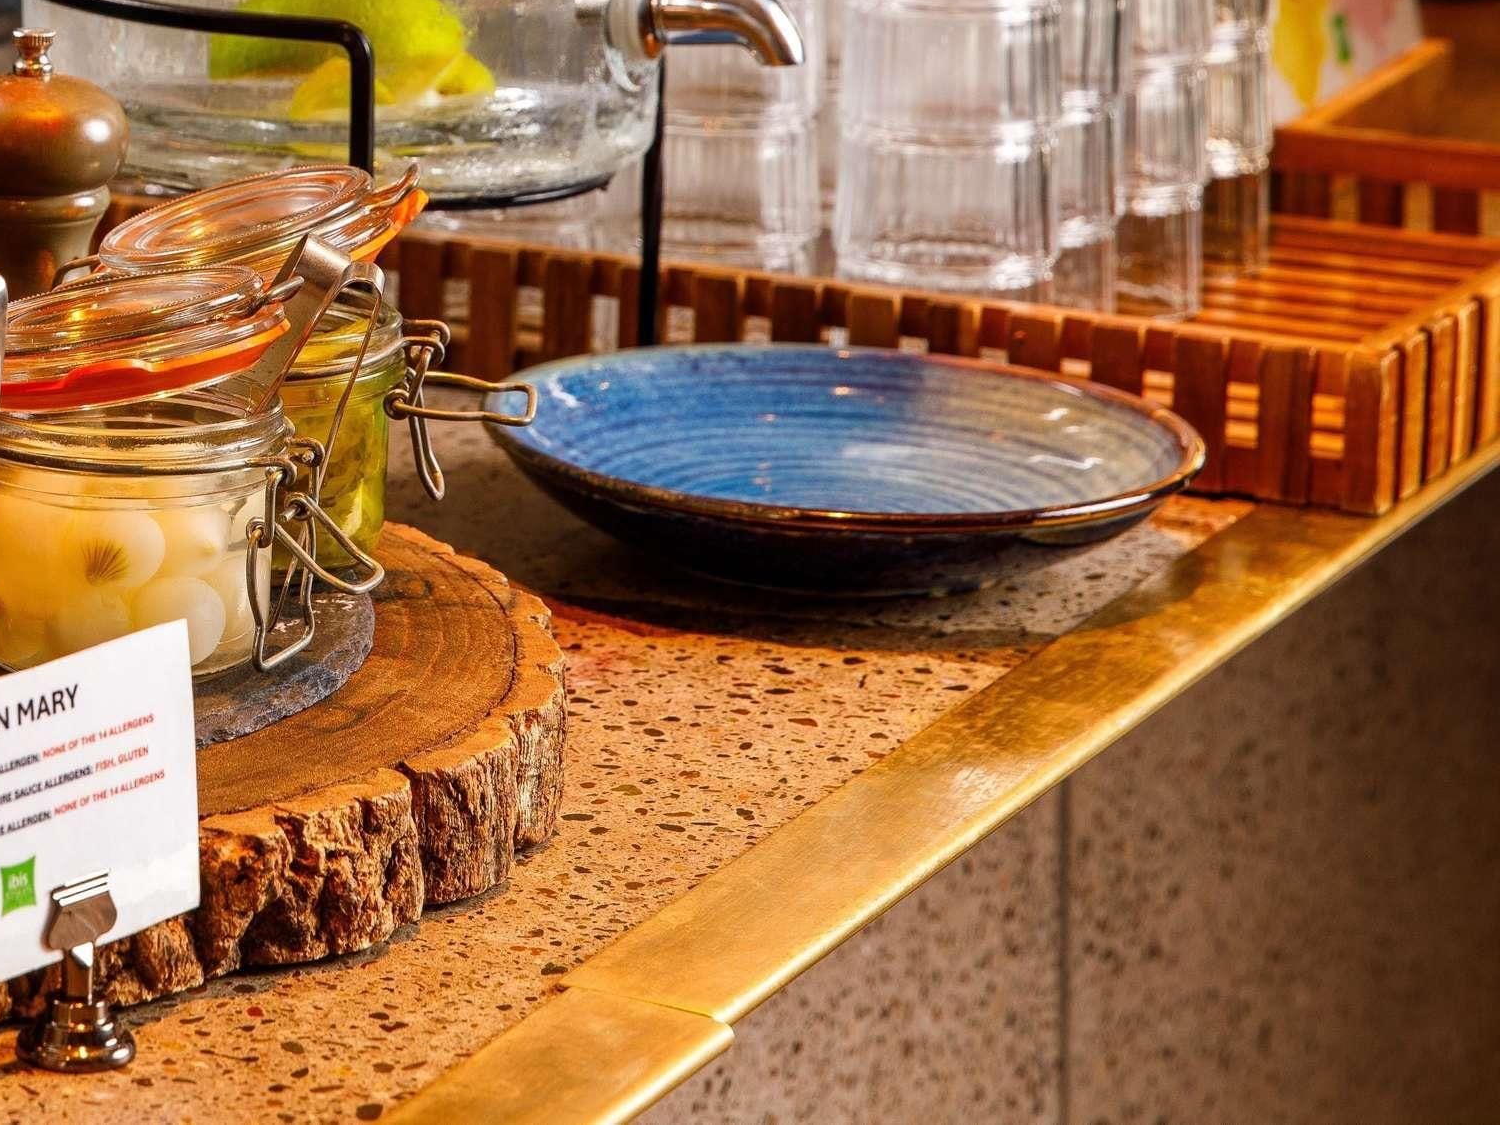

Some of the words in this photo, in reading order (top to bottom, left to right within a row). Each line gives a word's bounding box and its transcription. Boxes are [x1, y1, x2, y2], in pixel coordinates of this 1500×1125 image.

[17, 683, 79, 726] MARY
[42, 743, 66, 758] NONE
[68, 739, 79, 750] OF
[81, 733, 96, 745] THE
[98, 730, 108, 740] 14
[108, 713, 155, 737] ALLERGENS
[14, 781, 42, 800] SAUCE
[117, 745, 149, 764] GLUTEN
[53, 800, 78, 816] NONE
[80, 796, 90, 807] OF
[92, 790, 107, 802] THE
[110, 787, 119, 796] 14
[119, 769, 166, 793] ALLERGENS
